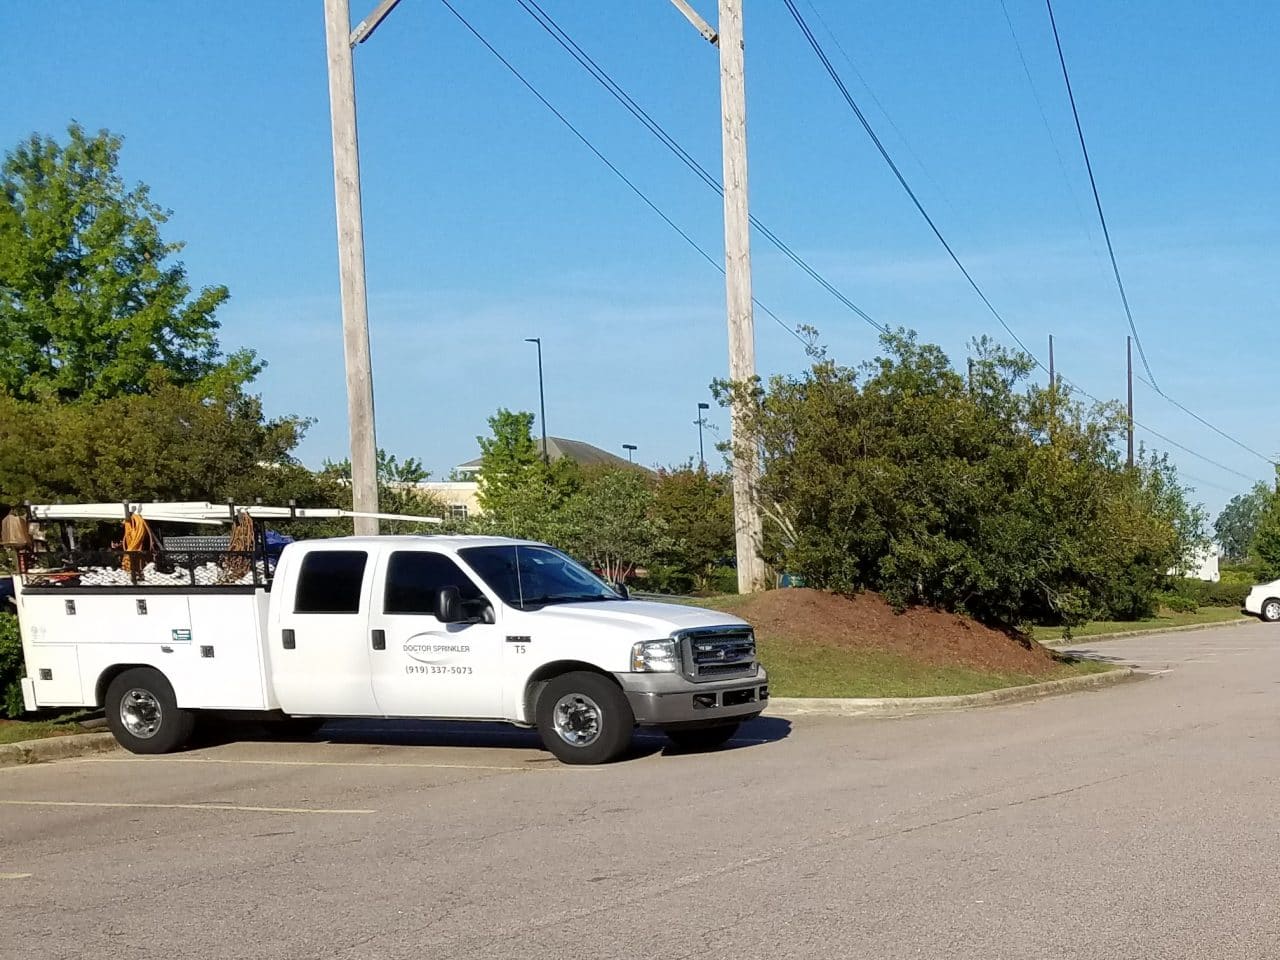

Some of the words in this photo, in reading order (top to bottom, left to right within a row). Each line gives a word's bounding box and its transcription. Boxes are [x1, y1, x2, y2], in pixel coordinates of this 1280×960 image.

[514, 645, 526, 654] T5
[405, 666, 429, 675] (919)
[431, 666, 473, 675] 337-5073
